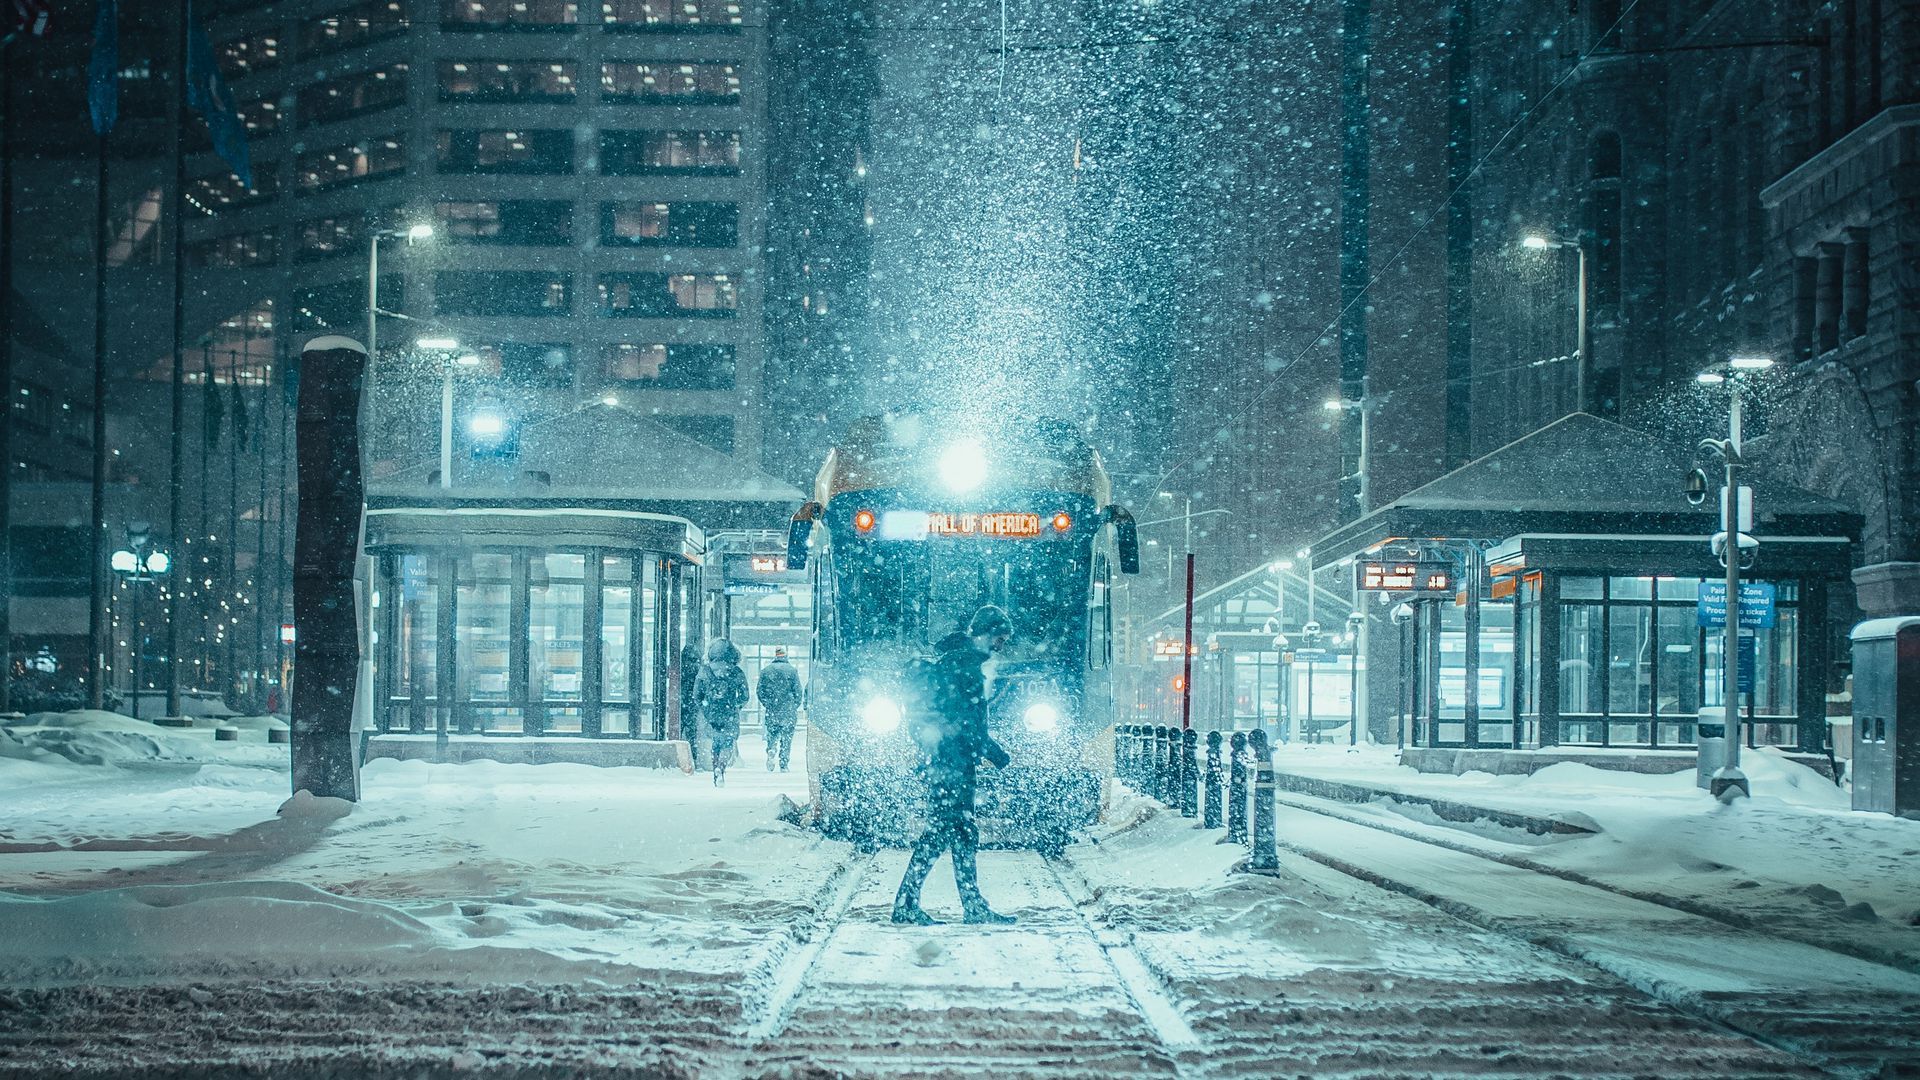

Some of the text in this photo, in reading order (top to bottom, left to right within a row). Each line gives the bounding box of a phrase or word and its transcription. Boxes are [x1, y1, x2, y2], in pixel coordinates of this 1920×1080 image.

[928, 514, 1038, 533] MALL OF AMERICA
[741, 585, 773, 593] TICKETS
[1703, 595, 1720, 603] Valid
[1738, 597, 1770, 605] Required
[1706, 606, 1726, 614] Proce
